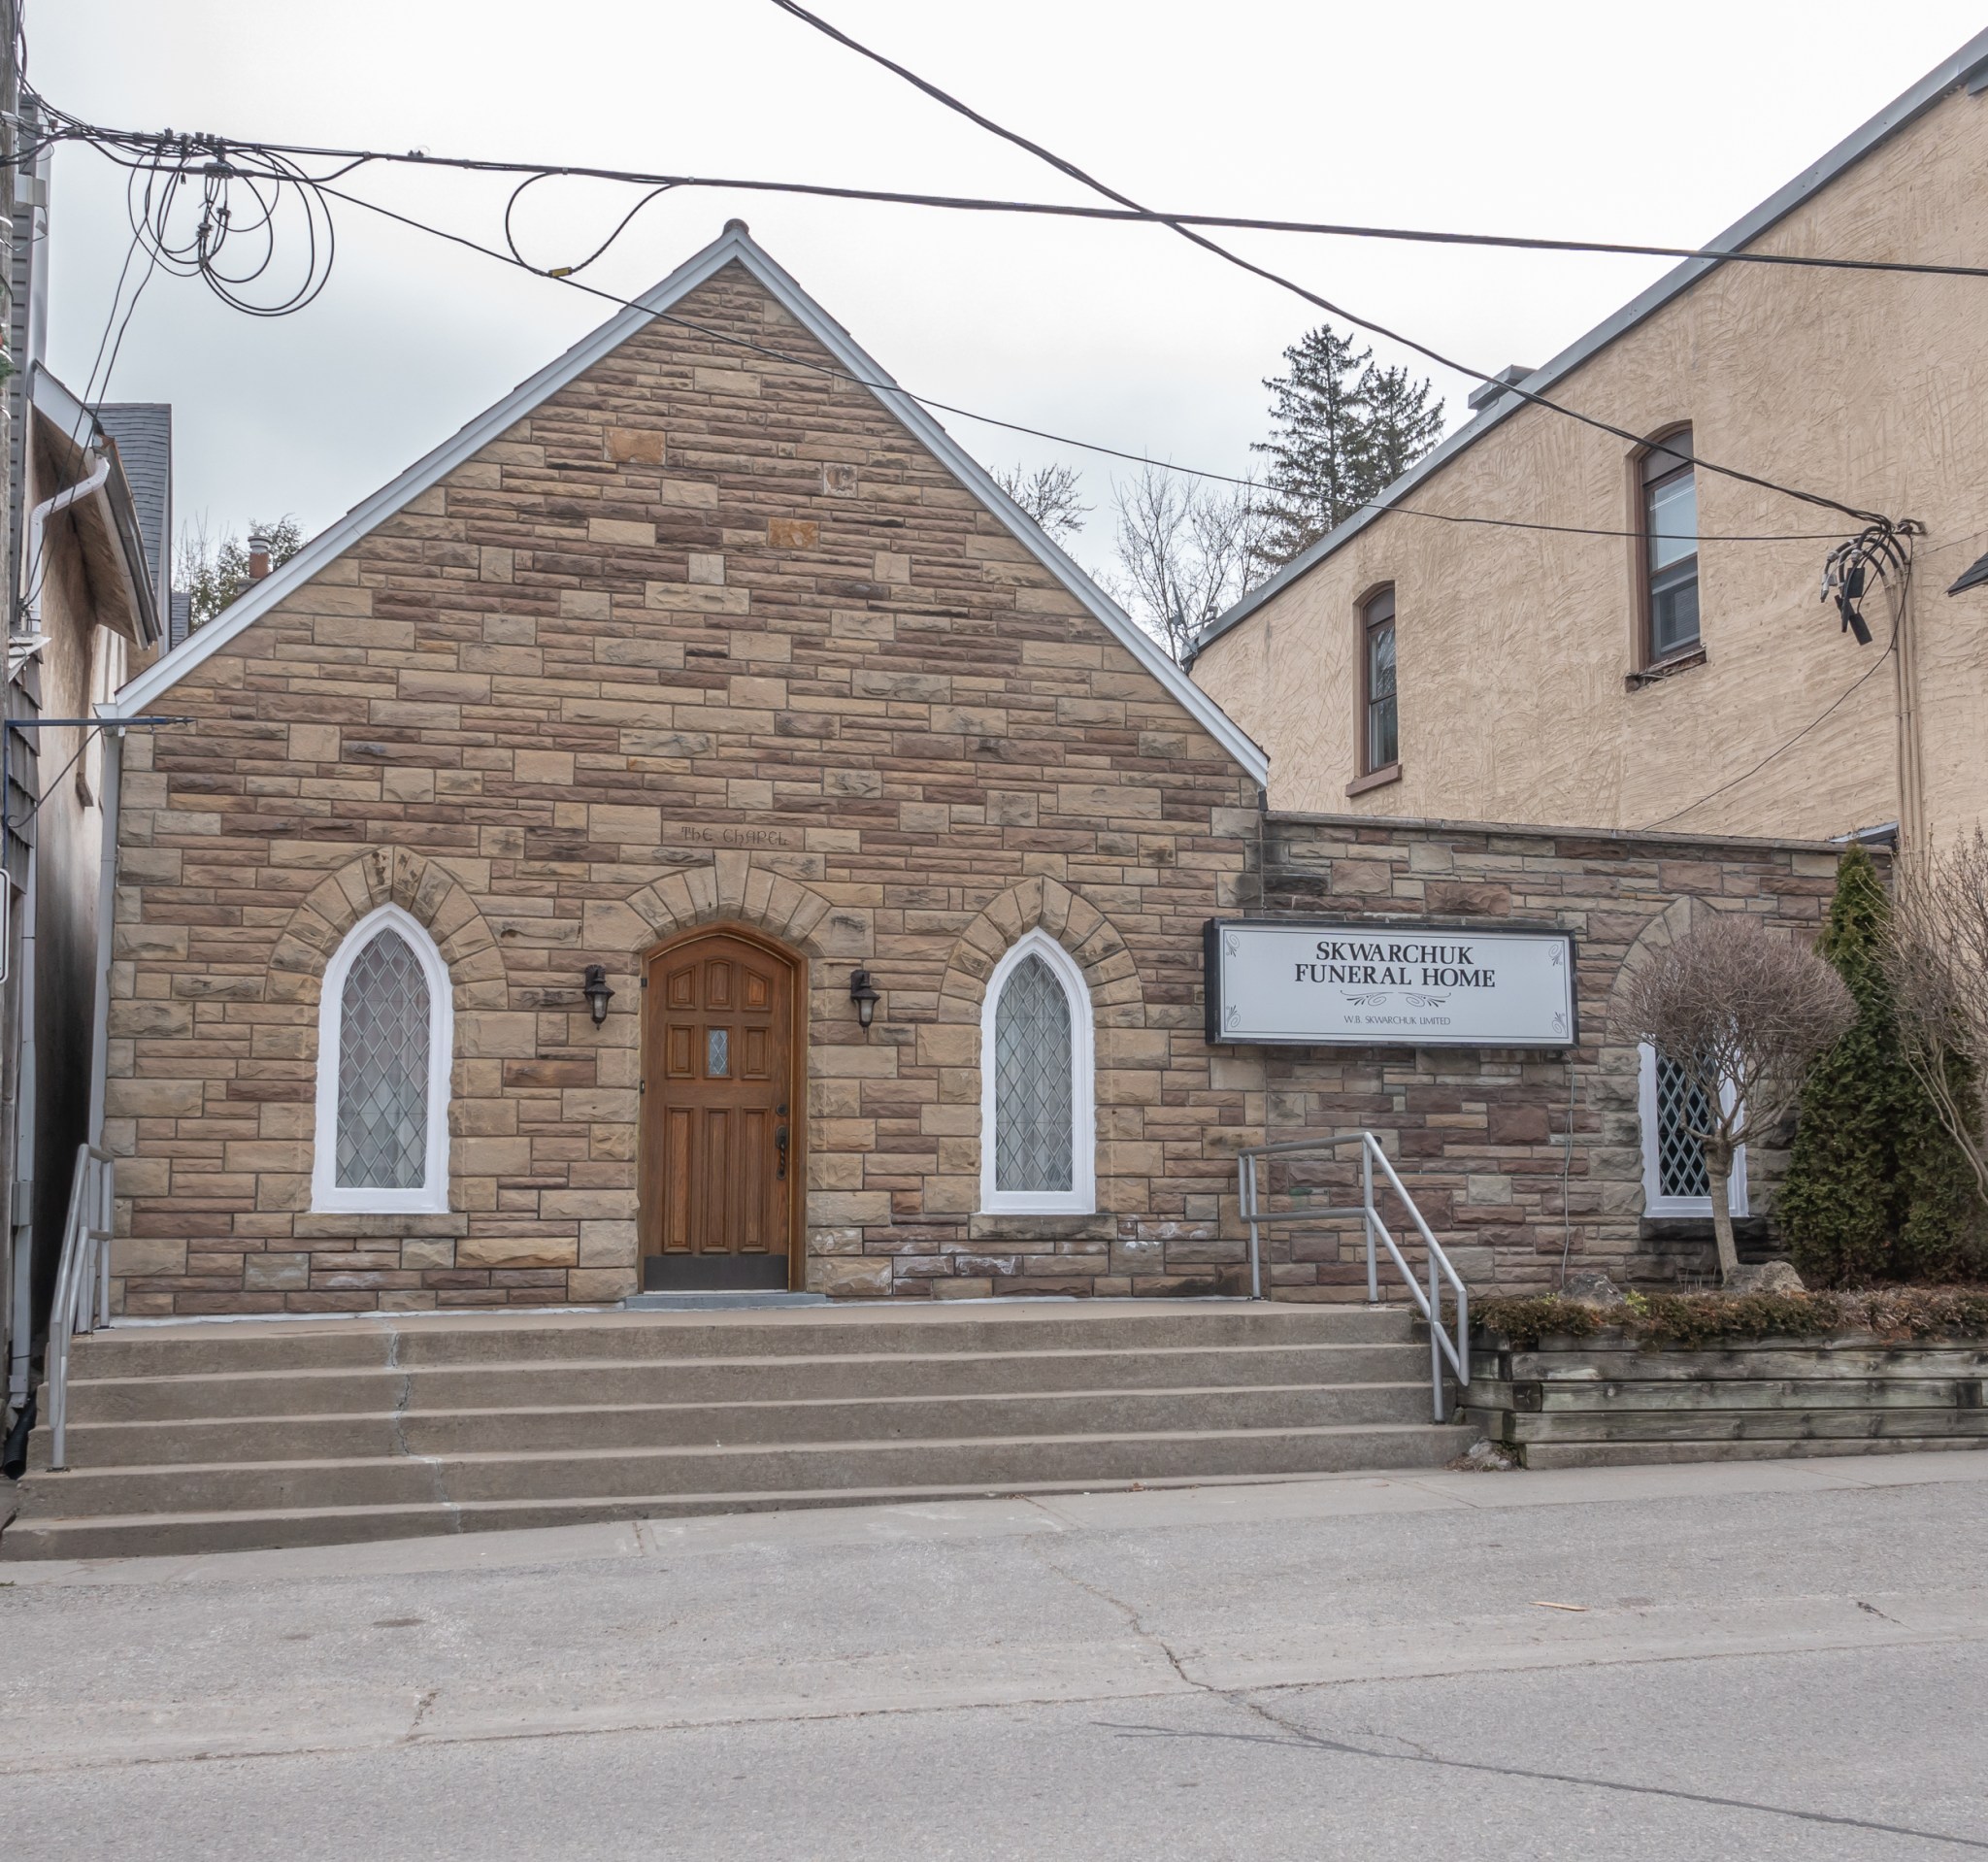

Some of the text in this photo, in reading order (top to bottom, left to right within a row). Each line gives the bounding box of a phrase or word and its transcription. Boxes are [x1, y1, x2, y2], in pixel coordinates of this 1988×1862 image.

[1316, 941, 1474, 965] SKWARCHUK
[1295, 963, 1496, 988] FUNERAL HOME
[1343, 1014, 1451, 1026] W.B. SKWARCHUK LIMITED
